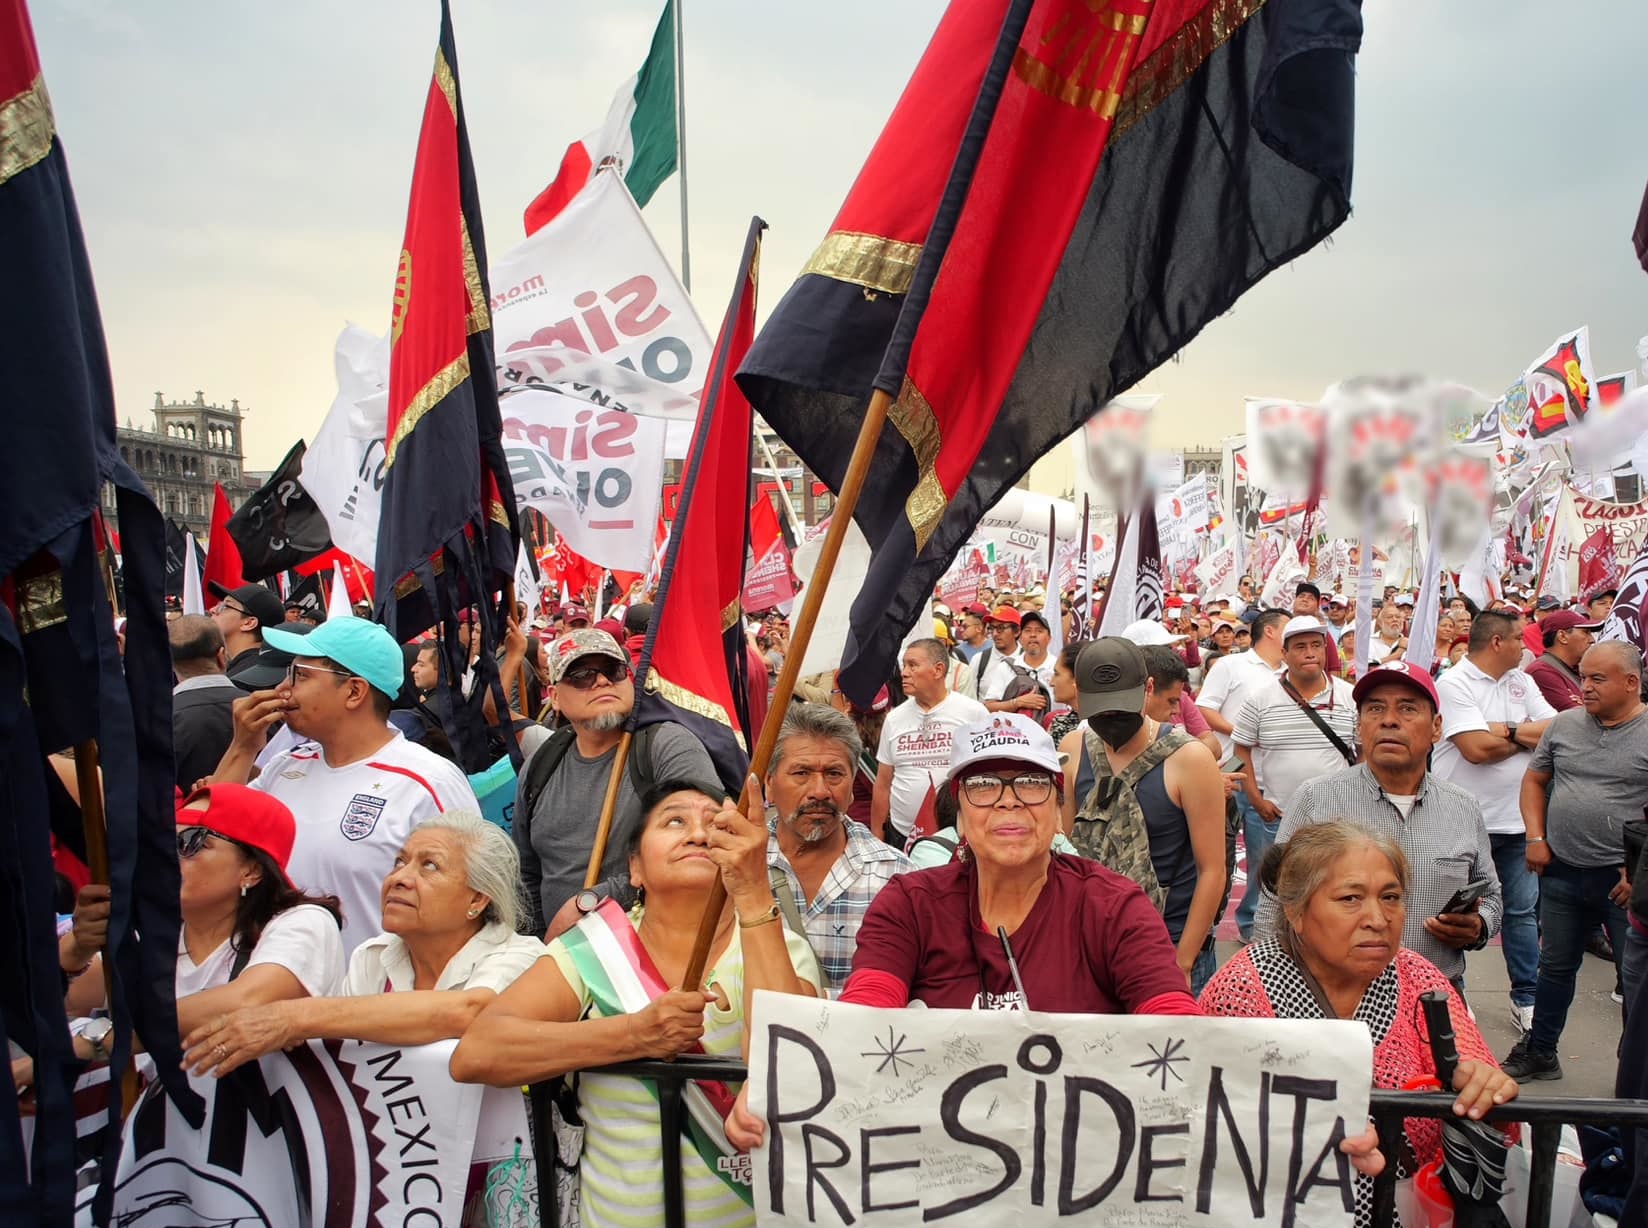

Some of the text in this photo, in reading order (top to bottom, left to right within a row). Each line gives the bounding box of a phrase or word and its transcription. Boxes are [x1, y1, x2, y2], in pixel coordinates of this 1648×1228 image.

[1009, 530, 1040, 547] CON
[898, 731, 953, 745] CLAUDI
[973, 737, 1030, 753] CLAUDIA
[896, 740, 953, 752] SHEINBAU
[720, 1156, 752, 1170] LLE
